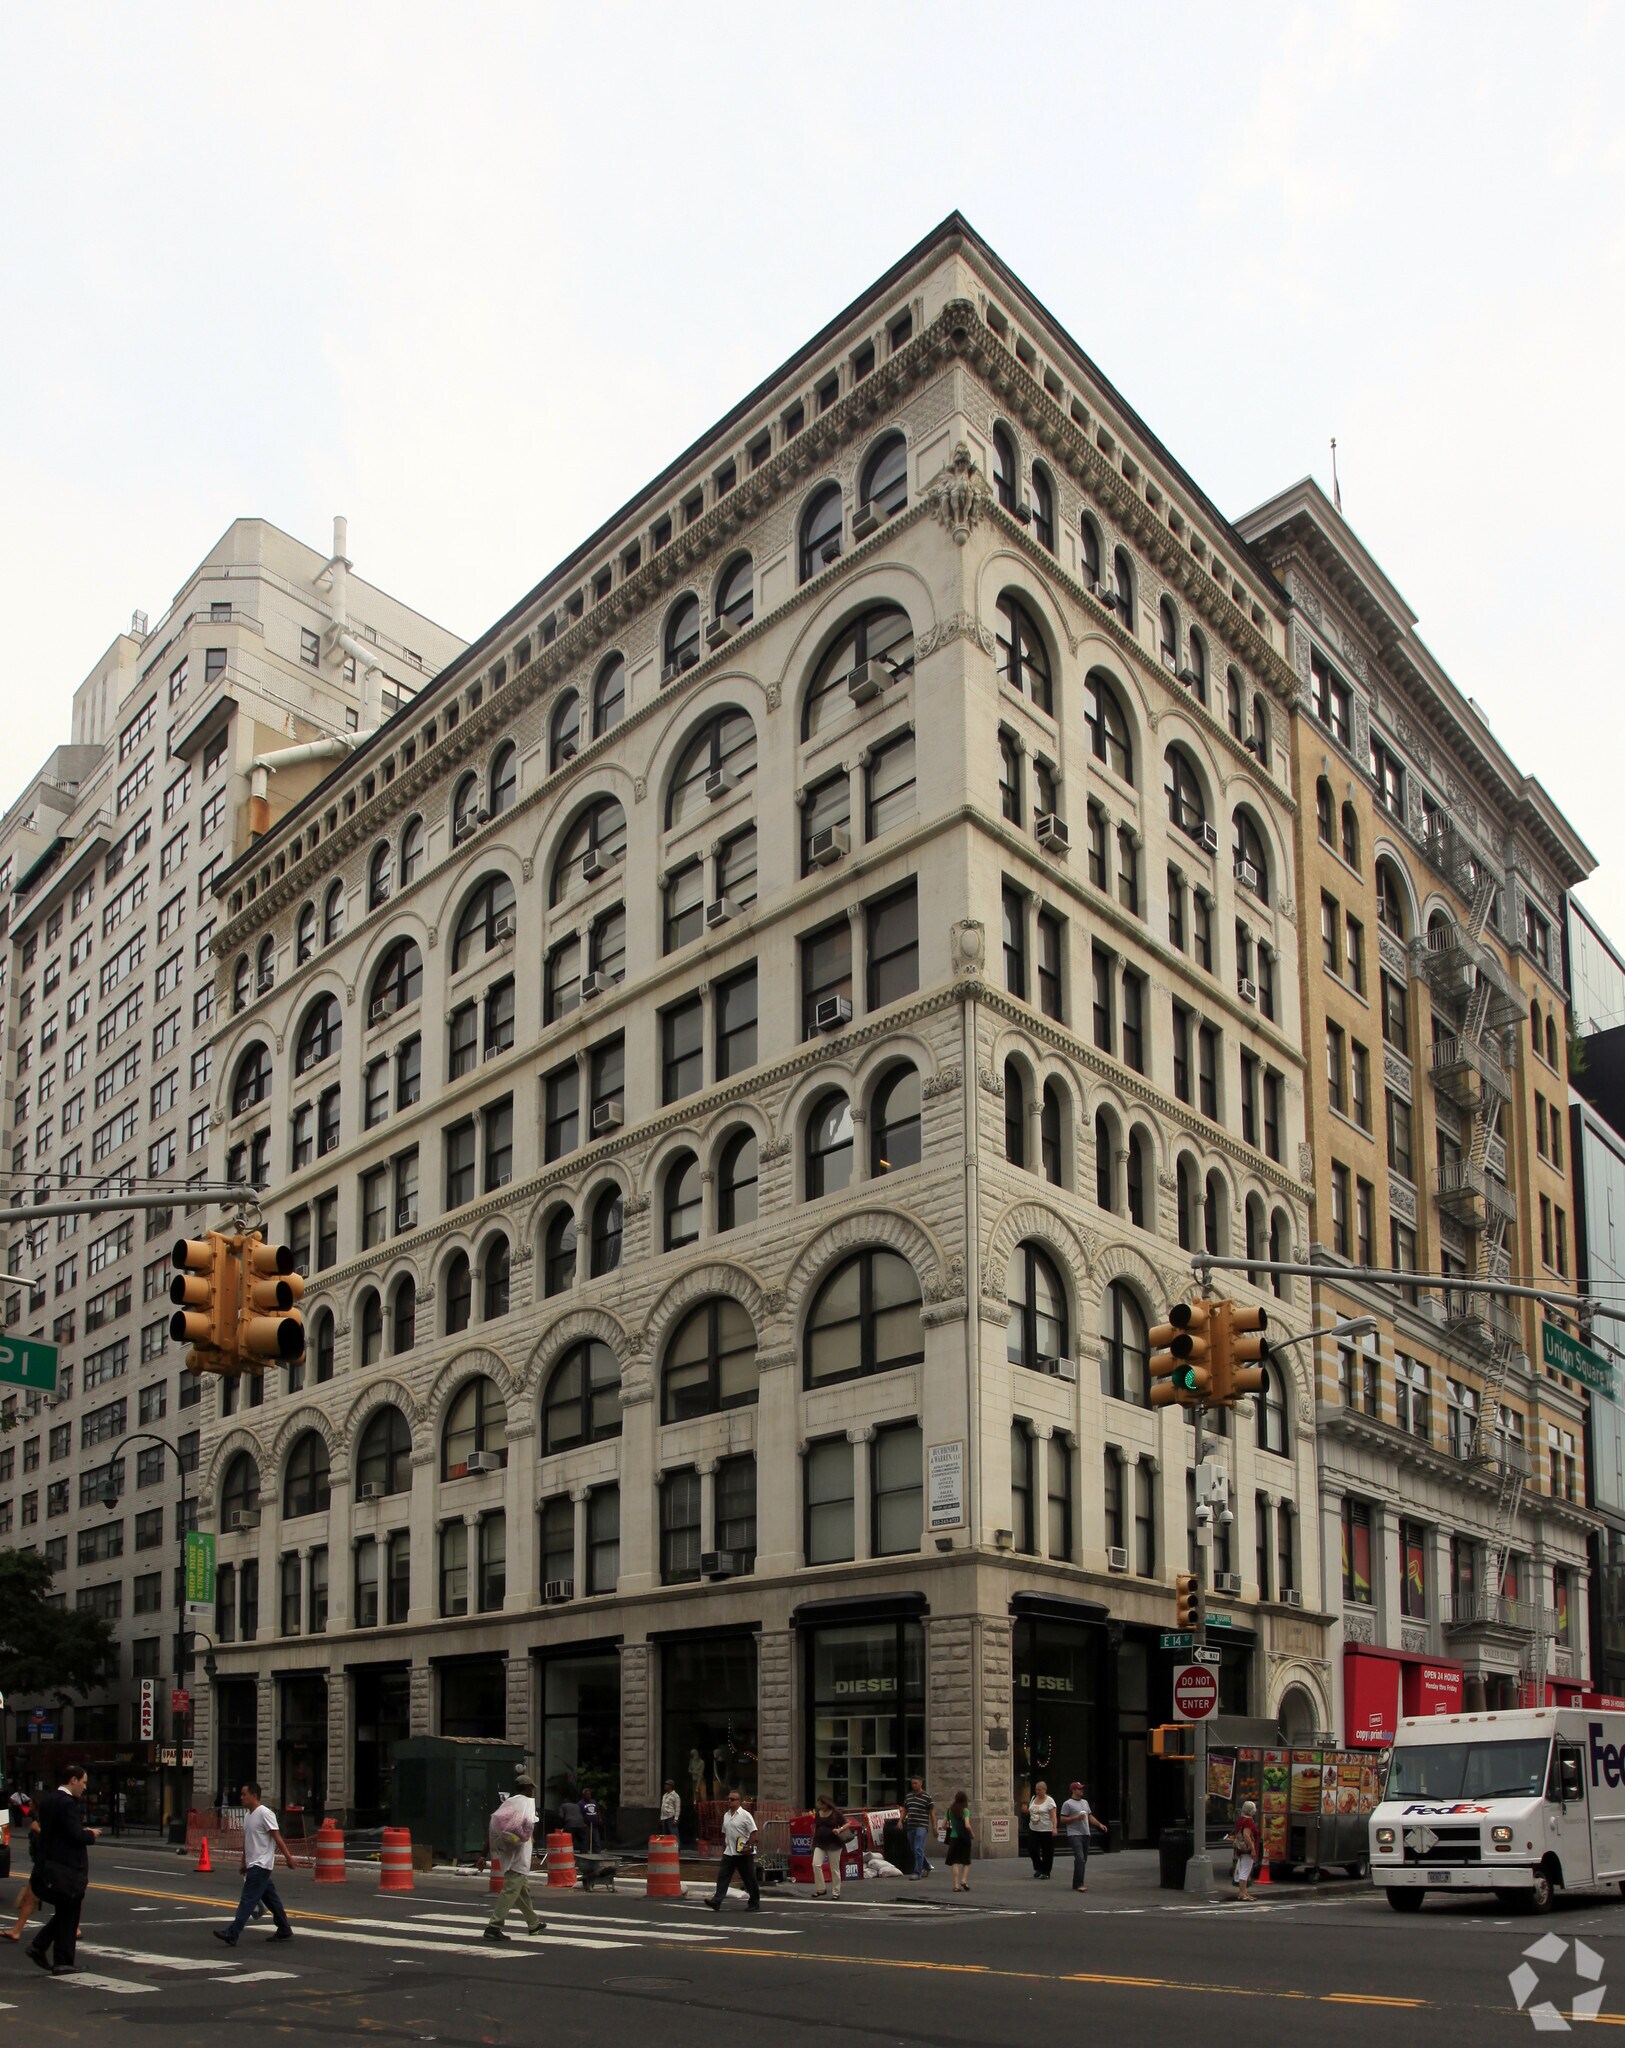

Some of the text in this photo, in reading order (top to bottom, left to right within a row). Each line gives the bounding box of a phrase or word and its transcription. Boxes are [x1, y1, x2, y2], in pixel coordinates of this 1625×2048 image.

[1546, 1332, 1574, 1367] Union
[1575, 1351, 1605, 1386] Square
[188, 1571, 196, 1599] SHOP
[1164, 1636, 1169, 1646] E
[1173, 1636, 1181, 1646] 14
[1198, 1651, 1219, 1660] ONE WAY
[1181, 1676, 1211, 1686] DO NOT
[1423, 1670, 1460, 1682] OPEN 24 HOURS
[1021, 1673, 1074, 1692] DESEL
[1425, 1682, 1439, 1691] Monday
[1182, 1699, 1210, 1709] ENTER
[142, 1692, 152, 1727] PARK
[1402, 1804, 1496, 1816] FedEx
[792, 1837, 811, 1847] VOICE
[845, 1864, 858, 1874] am
